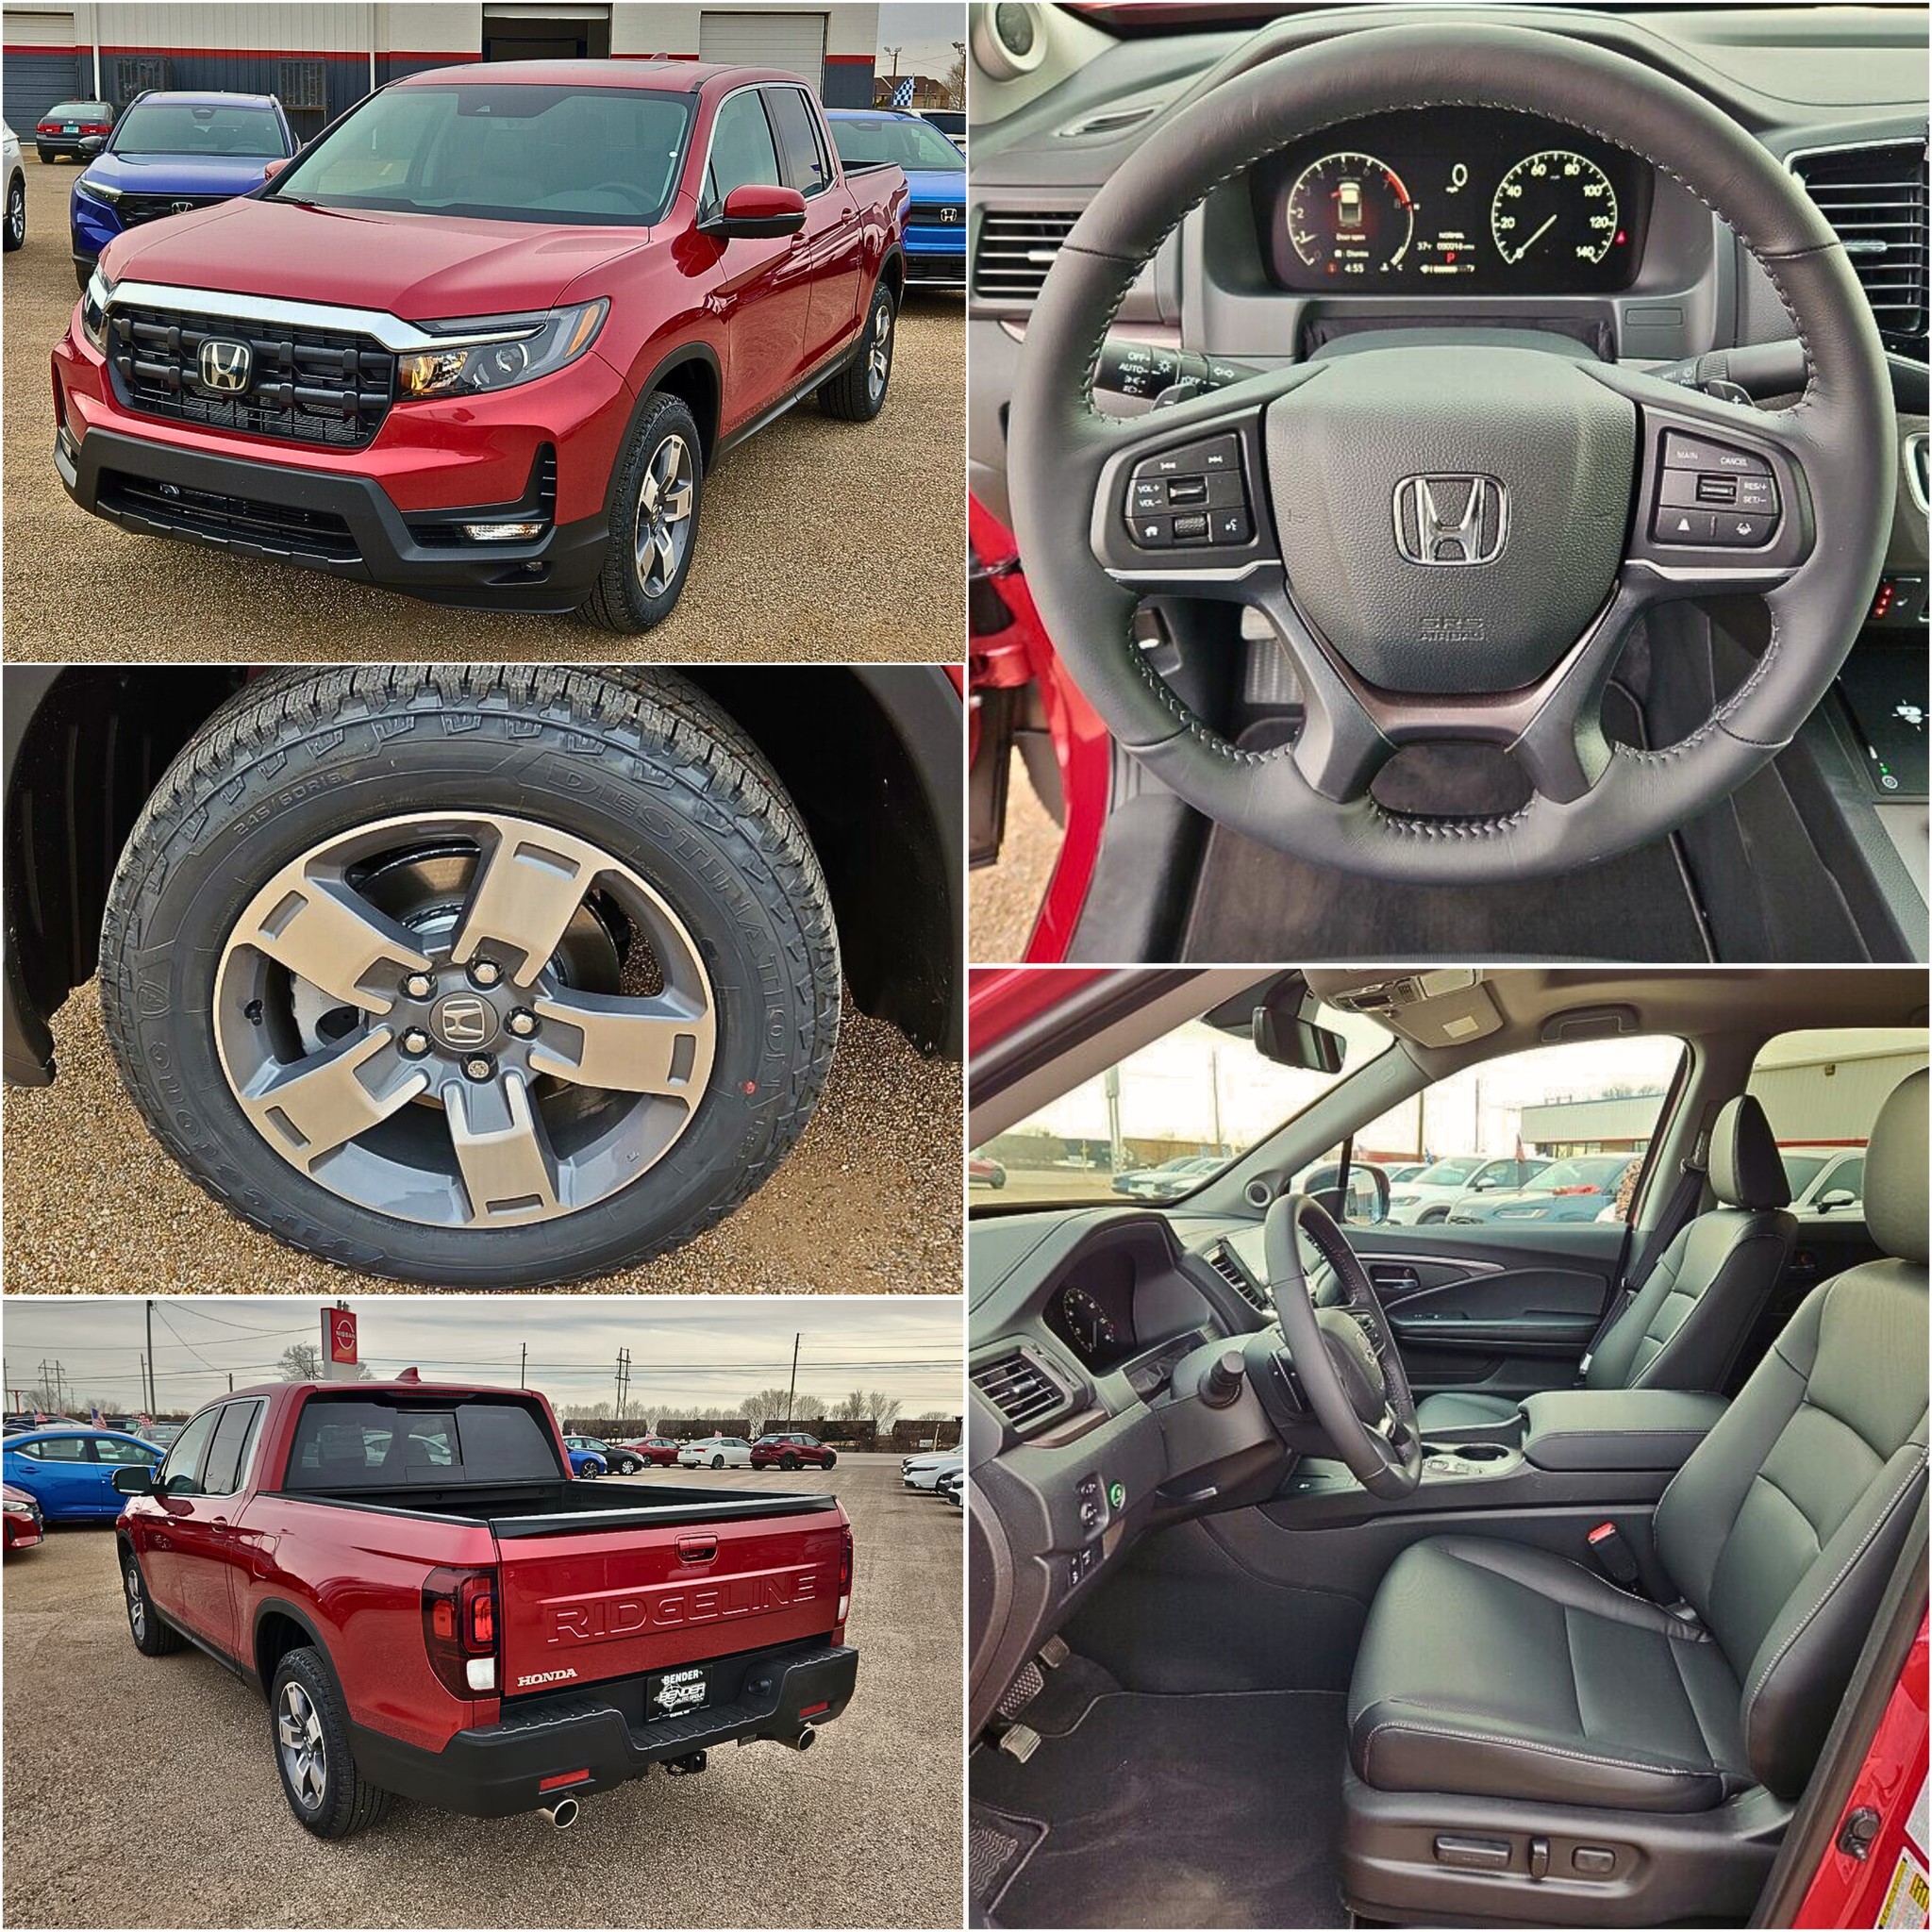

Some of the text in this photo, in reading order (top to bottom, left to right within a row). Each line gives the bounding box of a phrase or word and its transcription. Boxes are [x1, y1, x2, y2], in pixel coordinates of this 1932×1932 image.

[1452, 163, 1468, 187] 0
[1531, 164, 1547, 175] 60
[1564, 164, 1580, 175] 80
[1507, 185, 1522, 198] 40
[1584, 185, 1602, 197] 100
[1297, 208, 1304, 219] 2
[1500, 217, 1515, 229] 20
[1590, 217, 1609, 228] 120
[1576, 245, 1595, 258] 140
[1446, 252, 1456, 264] P
[1344, 263, 1364, 273] 4:55
[1119, 363, 1144, 374] AUTO
[1720, 457, 1748, 466] CANCEL
[548, 762, 787, 1090] DESTINATION
[336, 1330, 356, 1340] NISSAN
[546, 1574, 817, 1643] RIDGELINE
[517, 1667, 578, 1688] HONDA
[663, 1669, 699, 1686] BENDER
[658, 1682, 707, 1703] BENDER
